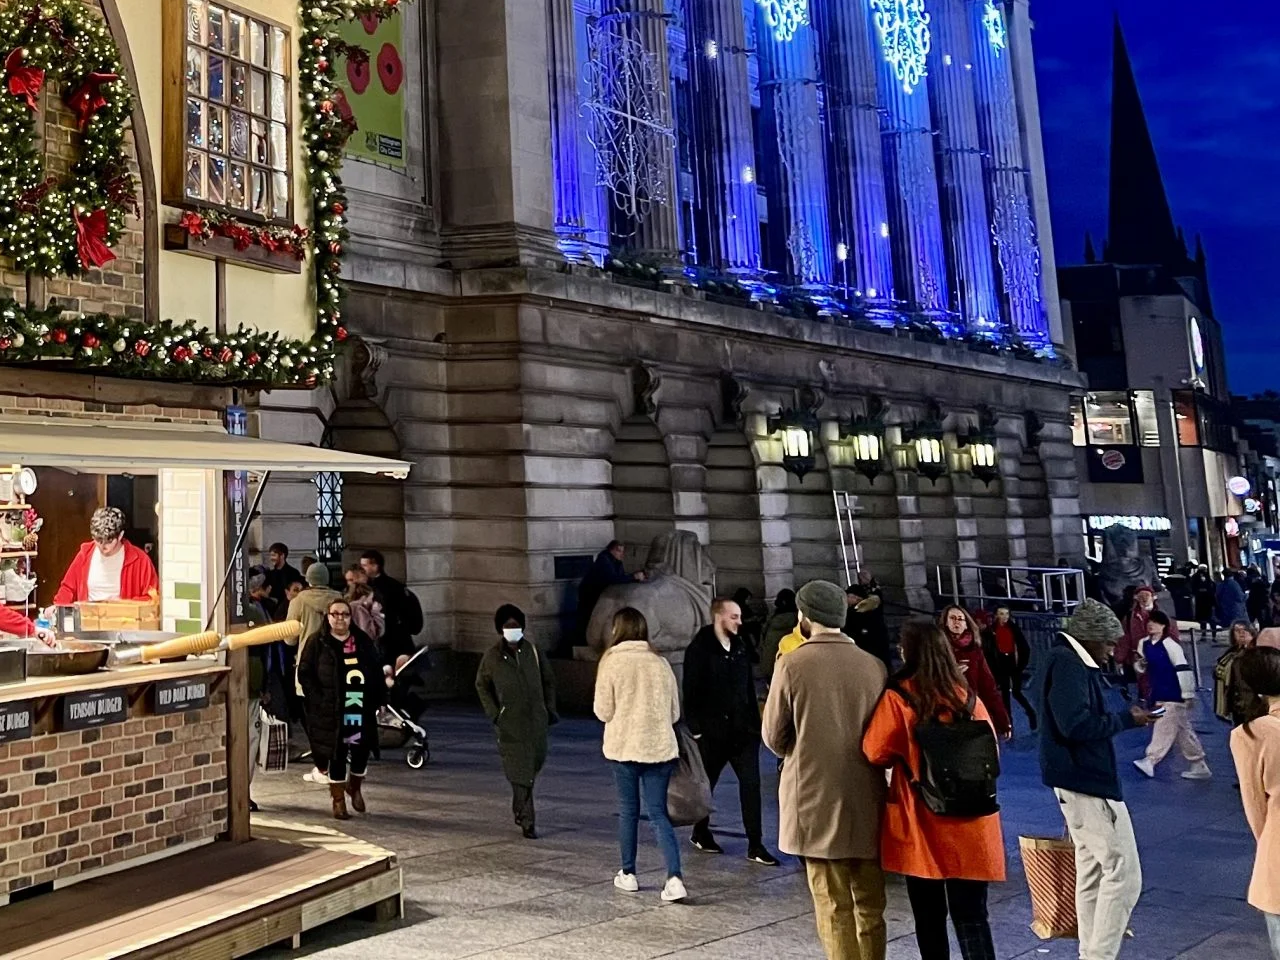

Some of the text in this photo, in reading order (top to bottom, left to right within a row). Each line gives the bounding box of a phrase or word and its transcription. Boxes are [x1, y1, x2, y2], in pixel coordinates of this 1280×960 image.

[234, 470, 243, 536] OURMET
[70, 696, 122, 720] VENISON BURGER
[6, 711, 29, 731] BURGER
